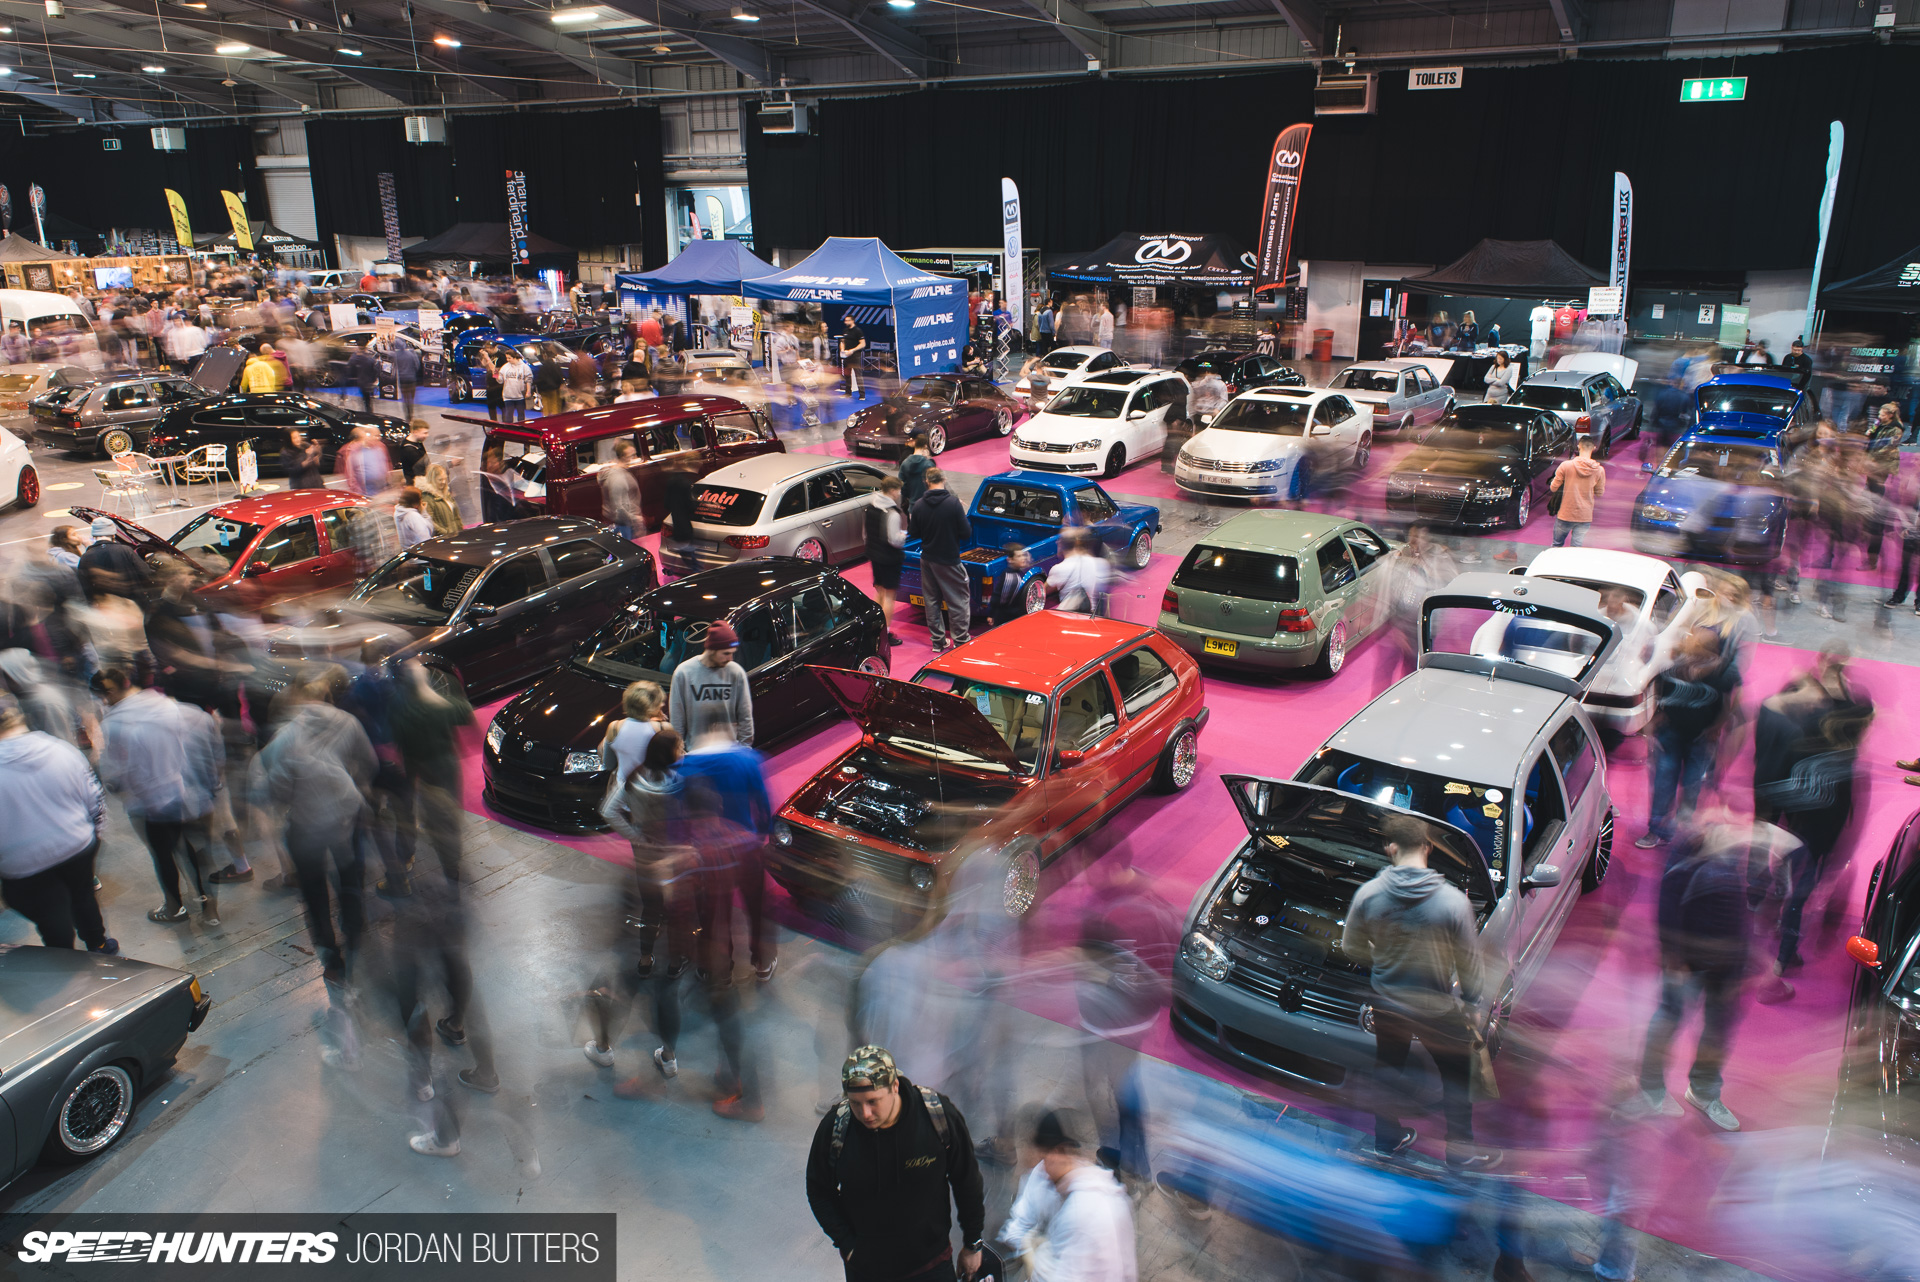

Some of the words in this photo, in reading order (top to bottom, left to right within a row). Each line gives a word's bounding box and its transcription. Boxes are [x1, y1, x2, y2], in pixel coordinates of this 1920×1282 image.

[1415, 72, 1457, 86] TOILETS
[1271, 178, 1298, 186] Motorsport
[1272, 173, 1298, 181] Creations
[507, 180, 527, 239] ferdinand
[1169, 233, 1203, 241] Motorsport
[1262, 218, 1276, 276] Performance
[1271, 192, 1280, 216] Parts
[273, 244, 307, 252] kodeshop
[1050, 272, 1078, 280] Creations
[1079, 274, 1112, 282] Motorsport
[801, 288, 844, 300] ALPINE
[919, 285, 953, 299] ALPINE
[921, 312, 954, 328] ALPINE
[914, 337, 955, 351] www.alpine.co.uk
[699, 489, 740, 506] kntrl
[442, 568, 480, 610] stillstatic
[1492, 599, 1538, 616] ROLLHARD
[1205, 638, 1236, 655] L9WCO
[690, 683, 732, 703] VANS
